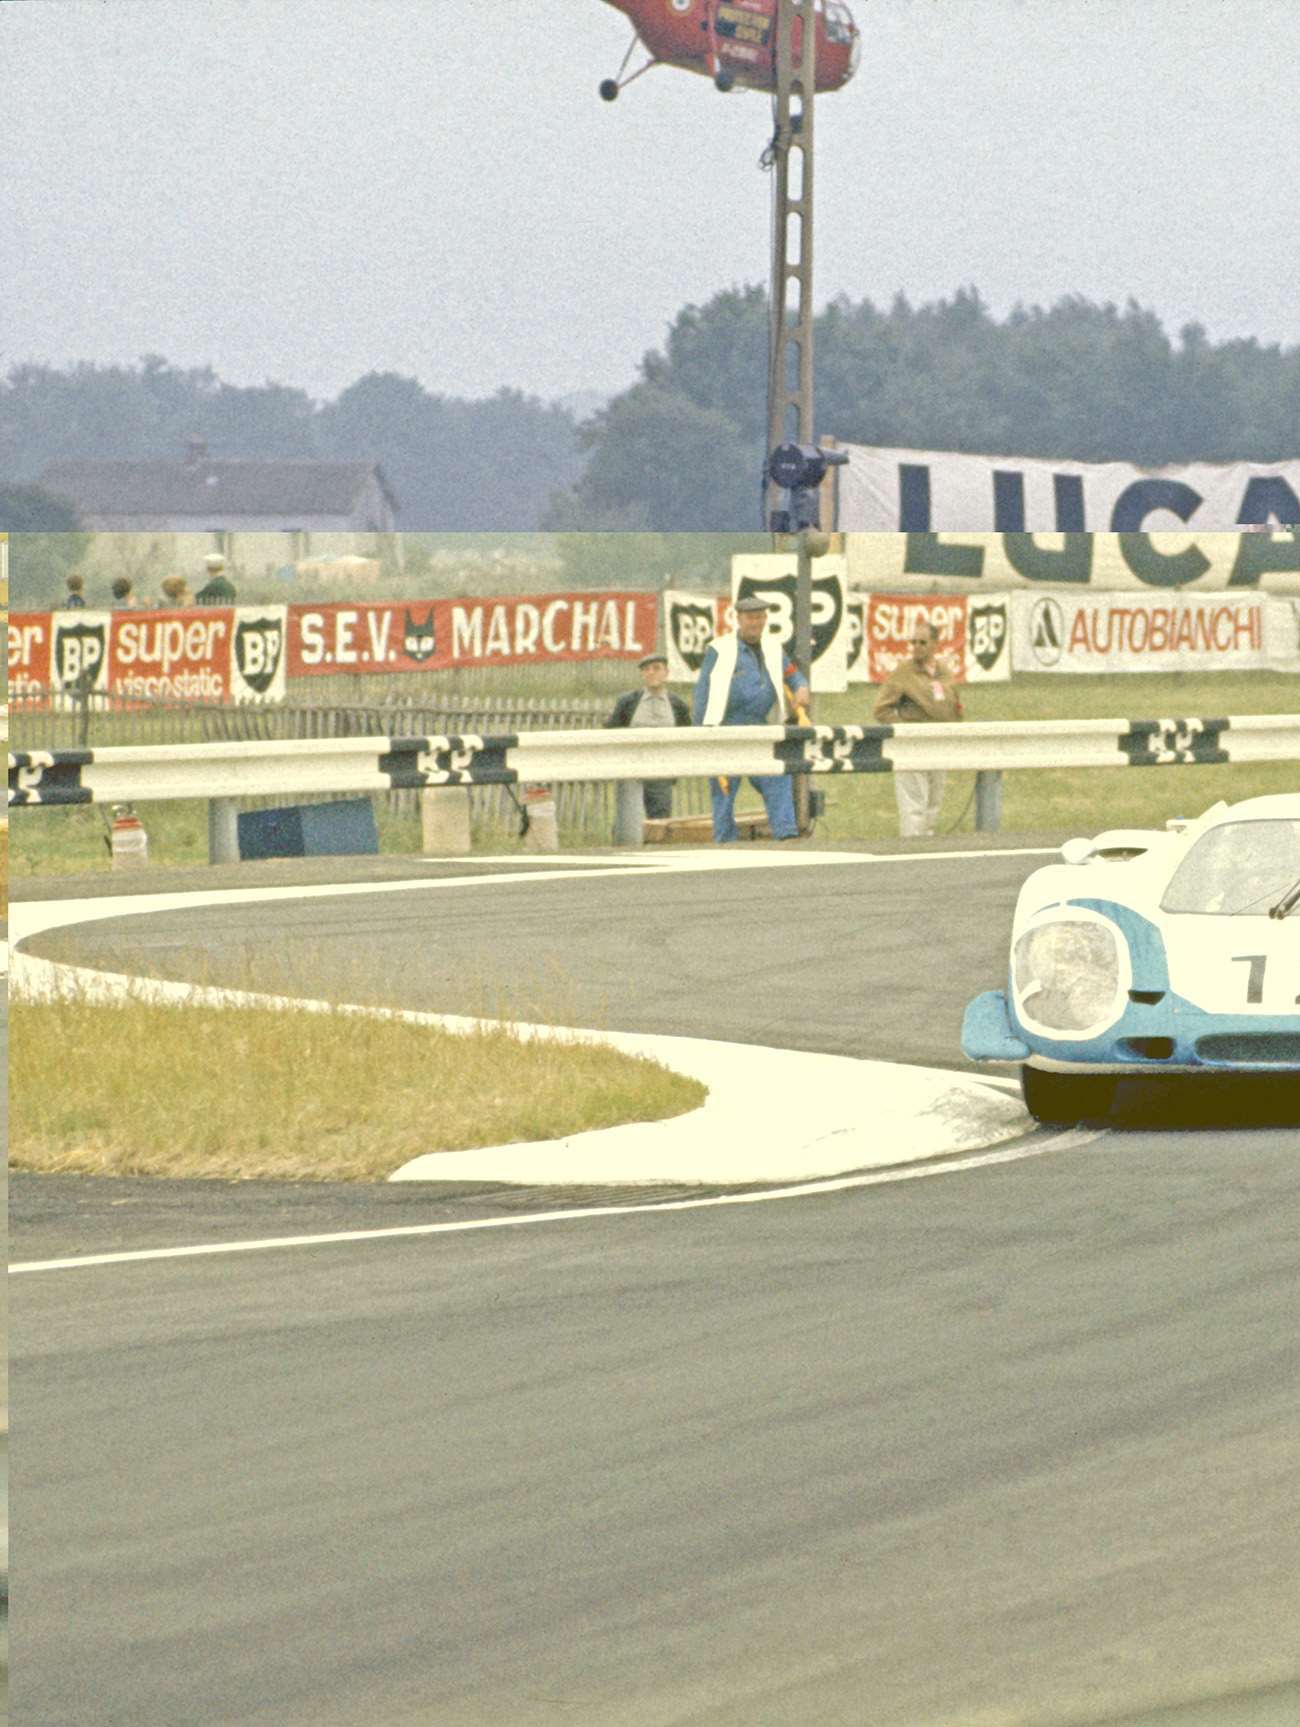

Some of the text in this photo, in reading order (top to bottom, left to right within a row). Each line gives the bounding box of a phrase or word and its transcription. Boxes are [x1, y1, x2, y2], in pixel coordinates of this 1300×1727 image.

[300, 600, 643, 663] S.E.V. MARCHAL
[872, 604, 963, 641] super
[1068, 607, 1264, 653] AUTOBIANCHI
[62, 635, 101, 681] BP
[116, 620, 226, 673] super
[242, 630, 281, 675] BP
